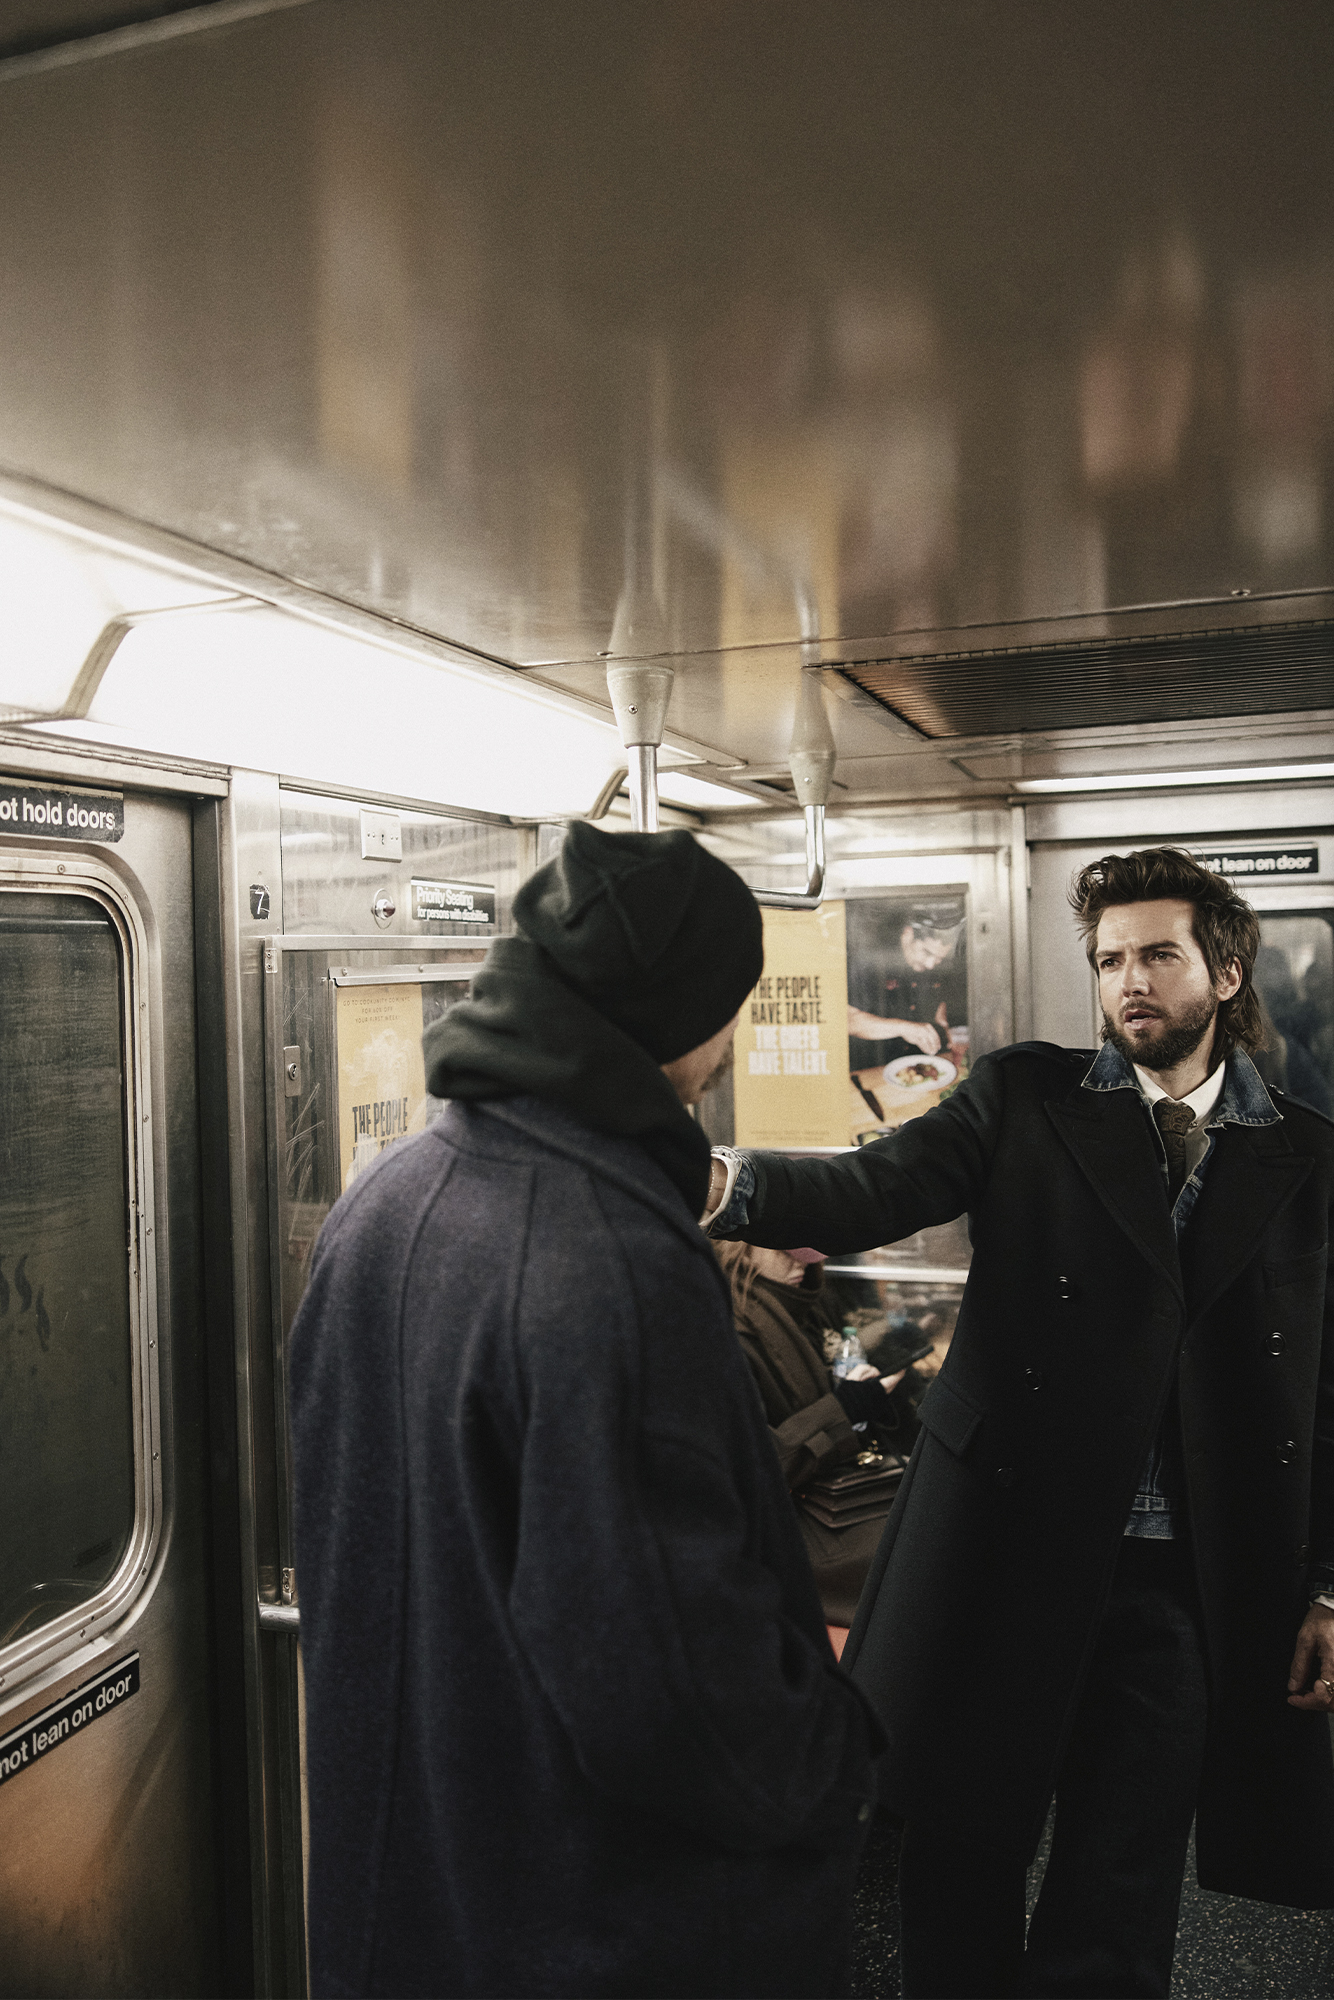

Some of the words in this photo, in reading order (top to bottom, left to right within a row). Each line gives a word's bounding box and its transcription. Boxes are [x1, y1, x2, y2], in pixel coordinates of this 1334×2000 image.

[23, 797, 62, 825] hold
[67, 803, 116, 830] doors
[1222, 856, 1255, 873] lean
[1255, 858, 1275, 871] on
[1276, 854, 1312, 870] door
[254, 891, 264, 915] 7
[416, 886, 446, 908] Priority
[446, 888, 474, 911] Seating
[417, 905, 427, 918] for
[426, 908, 450, 921] persons
[777, 976, 821, 998] PEOPLE
[751, 1002, 781, 1024] HAVE
[786, 1001, 826, 1024] TASTE.
[352, 1104, 371, 1143] THE
[373, 1097, 408, 1138] PEOPLE
[0, 1741, 28, 1779] not
[32, 1717, 69, 1755] lean
[71, 1702, 93, 1728] on
[95, 1674, 132, 1711] door
